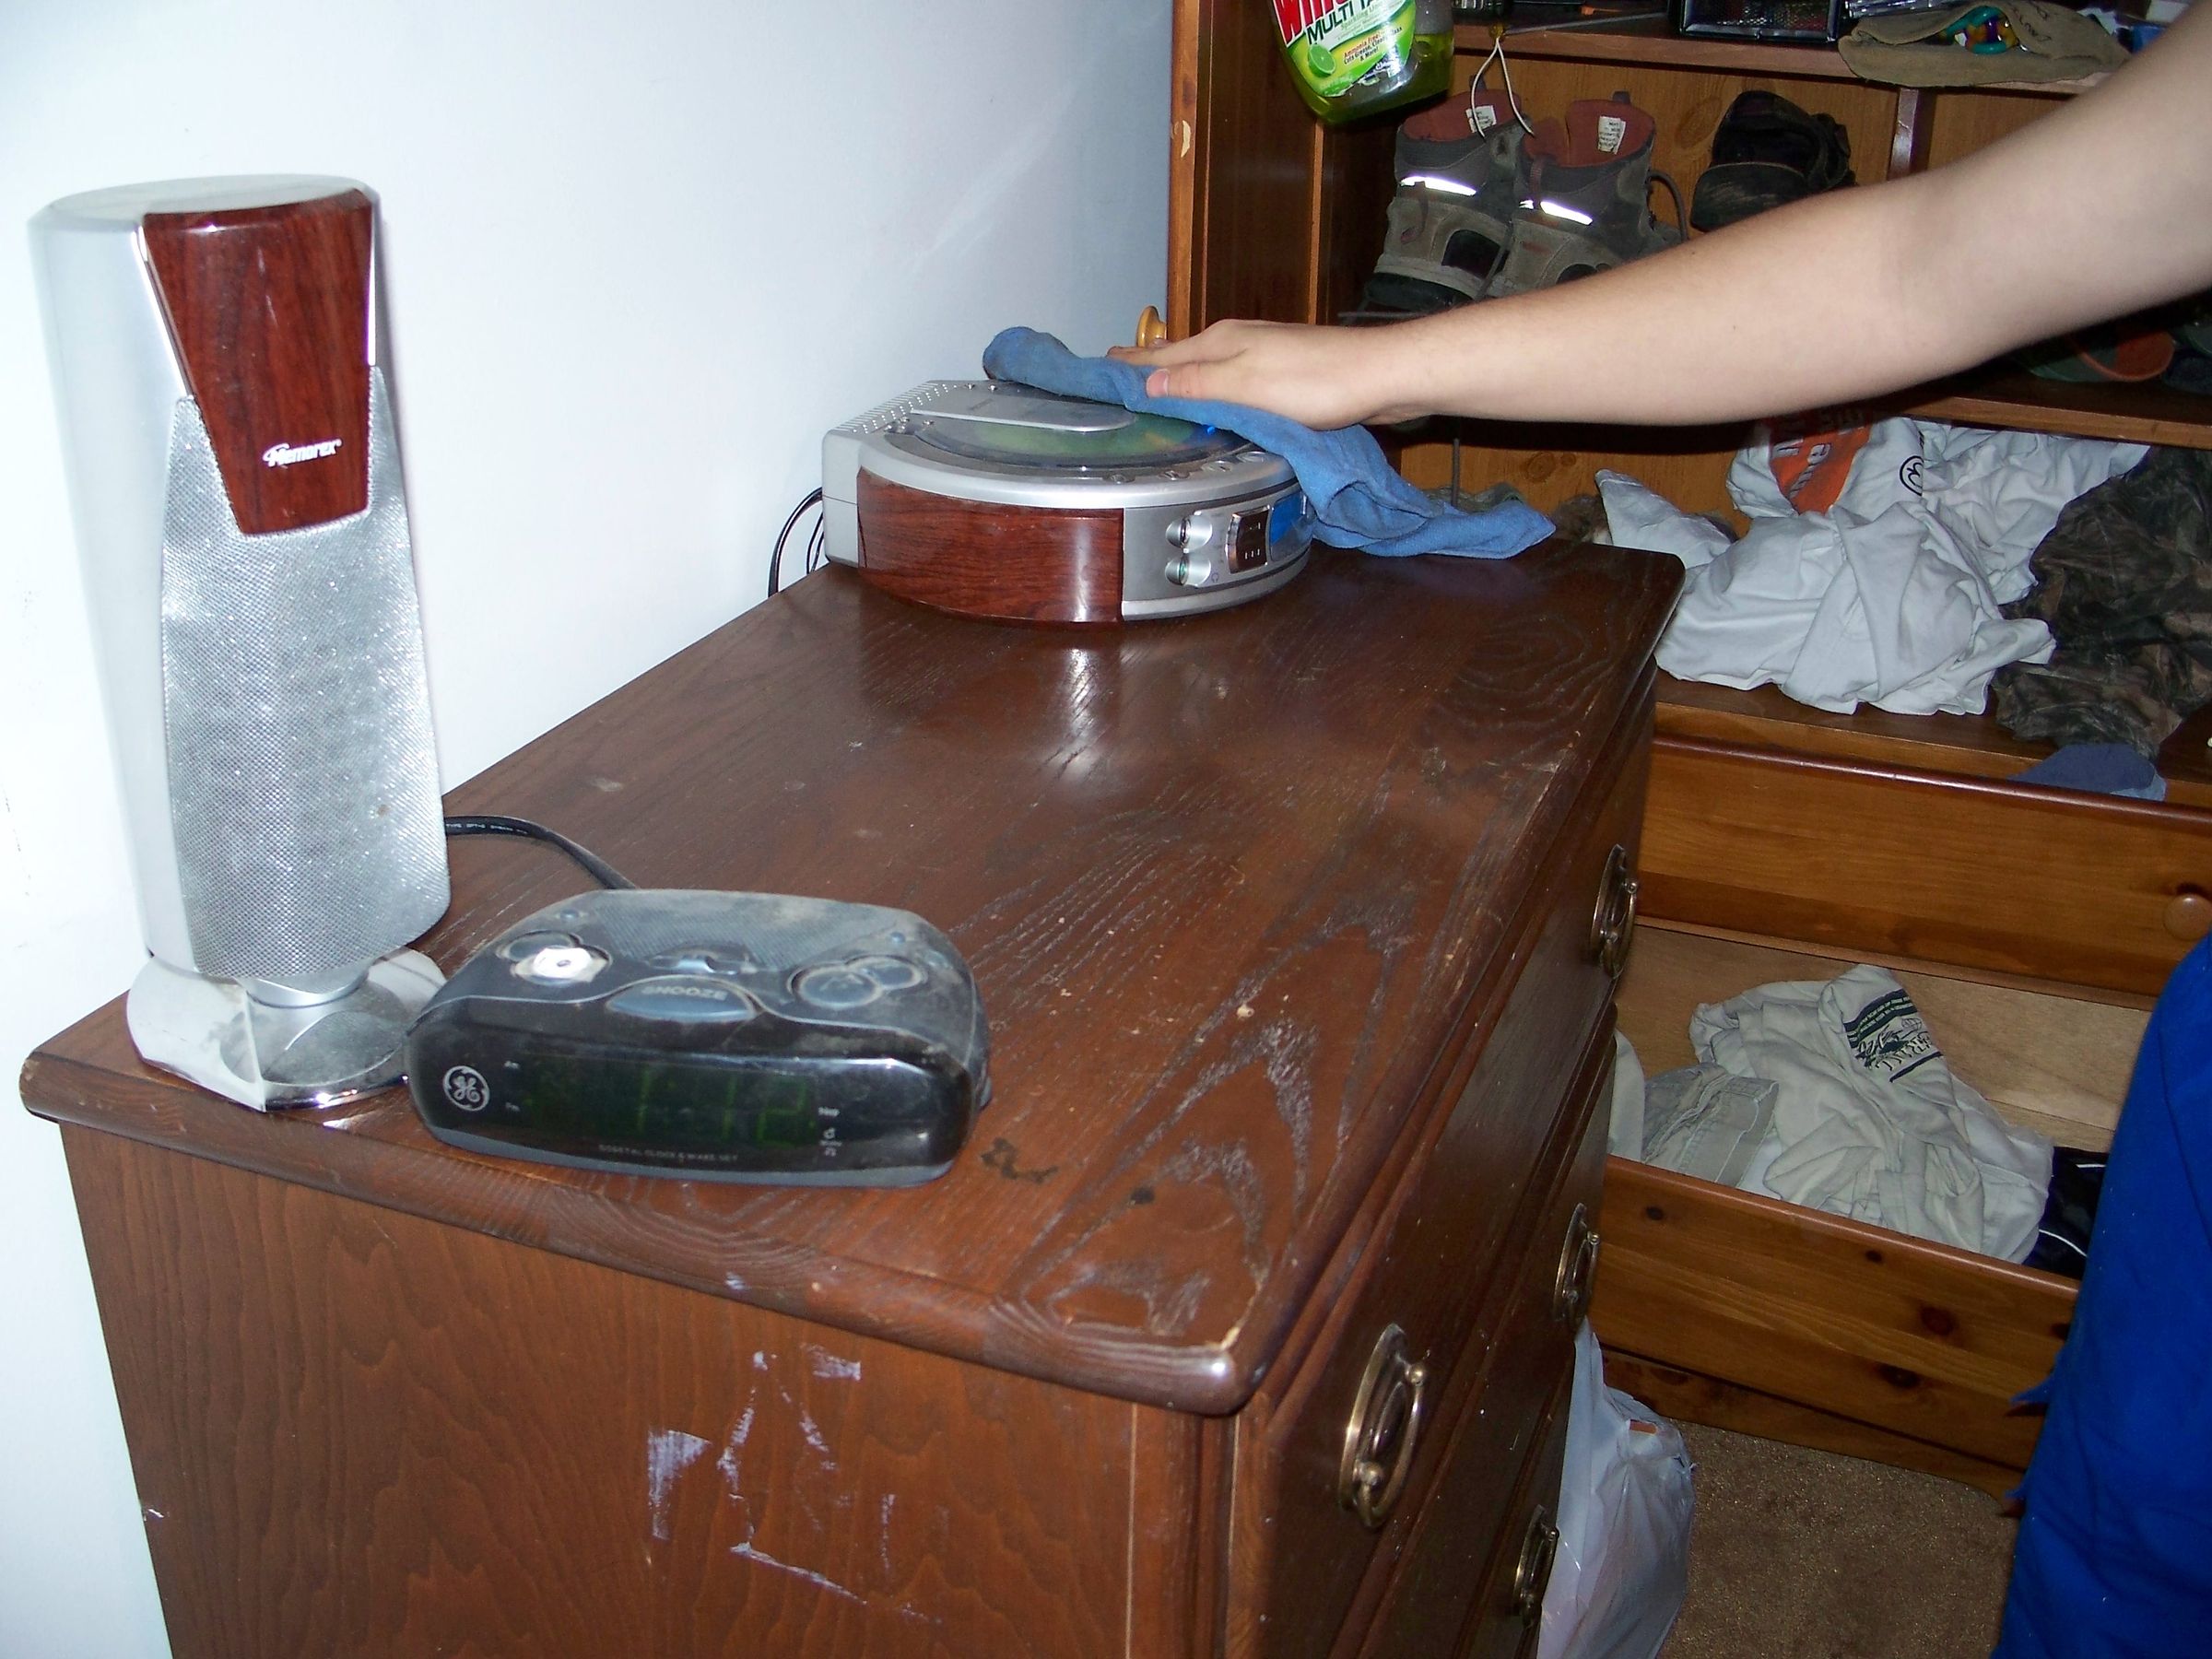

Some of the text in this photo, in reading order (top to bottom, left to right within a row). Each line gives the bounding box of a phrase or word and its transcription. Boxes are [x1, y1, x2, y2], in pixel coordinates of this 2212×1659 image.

[1306, 1, 1354, 44] MULTI
[263, 439, 342, 467] Memorex
[641, 986, 728, 1001] SNOOZE
